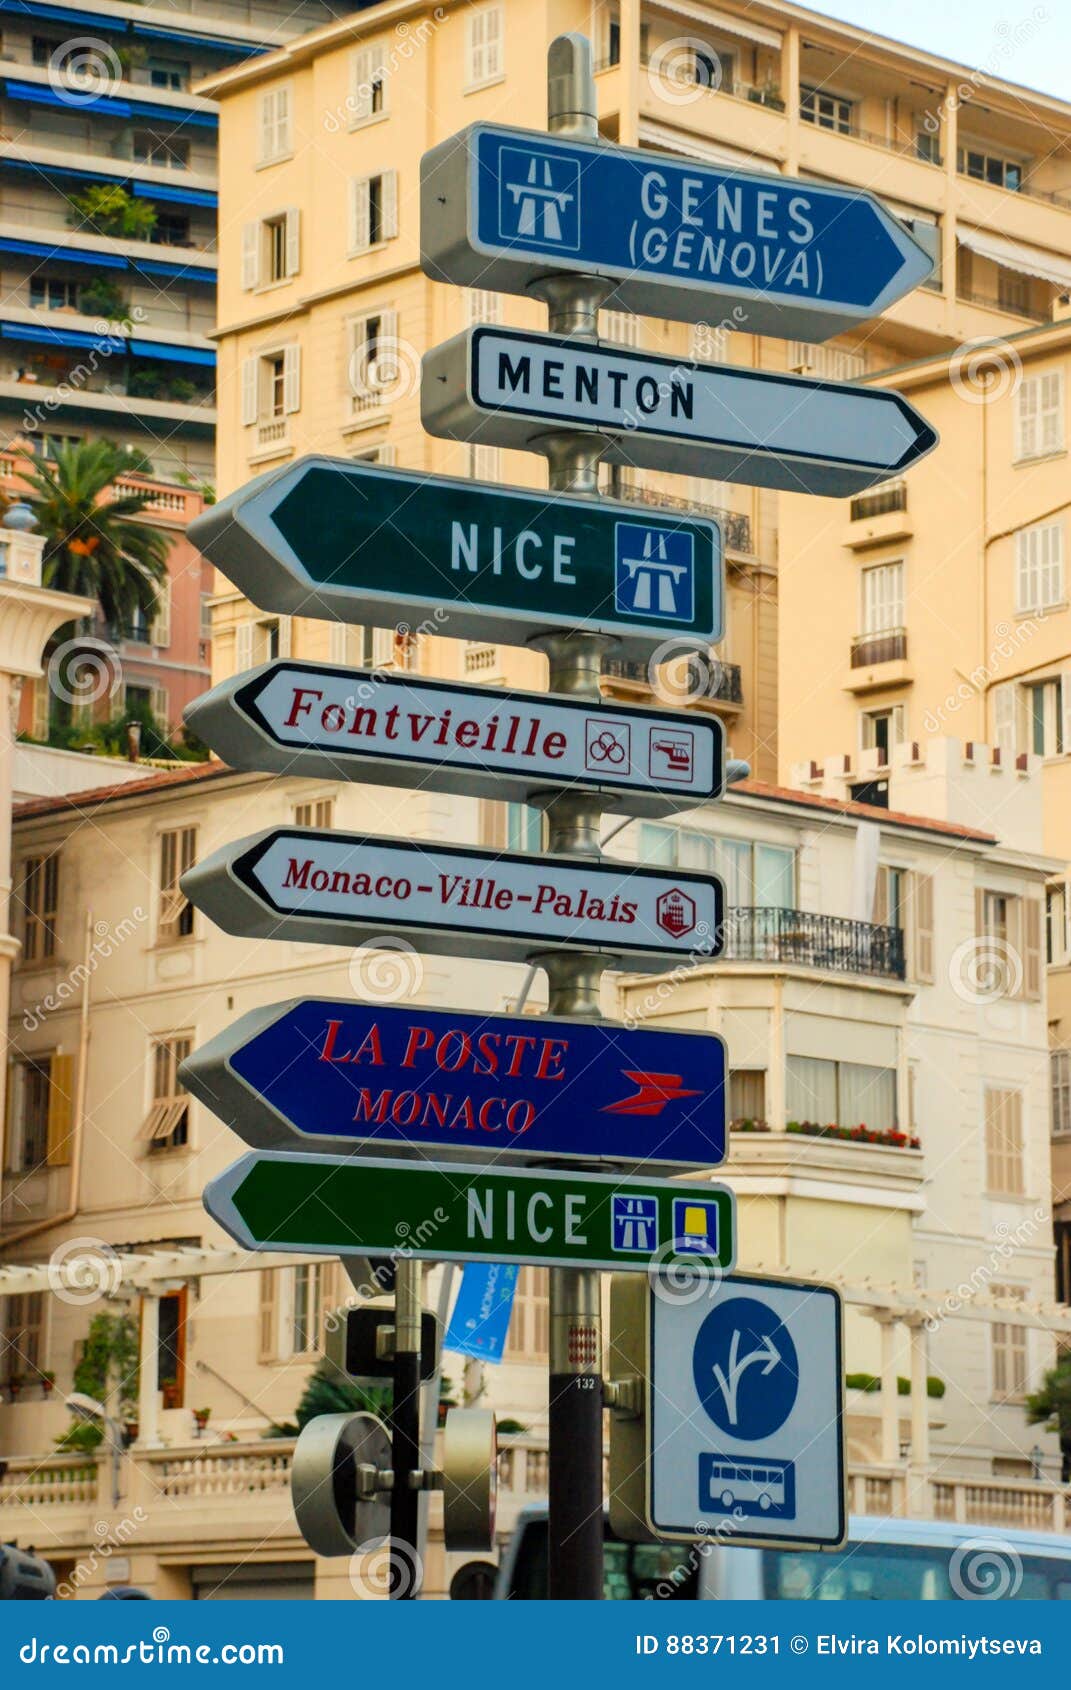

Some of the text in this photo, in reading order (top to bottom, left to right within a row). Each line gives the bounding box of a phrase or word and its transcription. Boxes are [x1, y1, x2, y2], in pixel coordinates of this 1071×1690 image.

[640, 170, 815, 245] GENES
[629, 219, 823, 295] (GENOVA)
[498, 352, 694, 420] MENTON
[451, 520, 577, 585] NICE
[283, 688, 567, 759] Fontvieille
[281, 858, 639, 924] Monaco-Ville-Palais
[318, 1019, 569, 1081] LA POSTE
[352, 1087, 536, 1134] MONACO
[466, 1187, 588, 1245] NICE
[575, 1378, 595, 1390] 132
